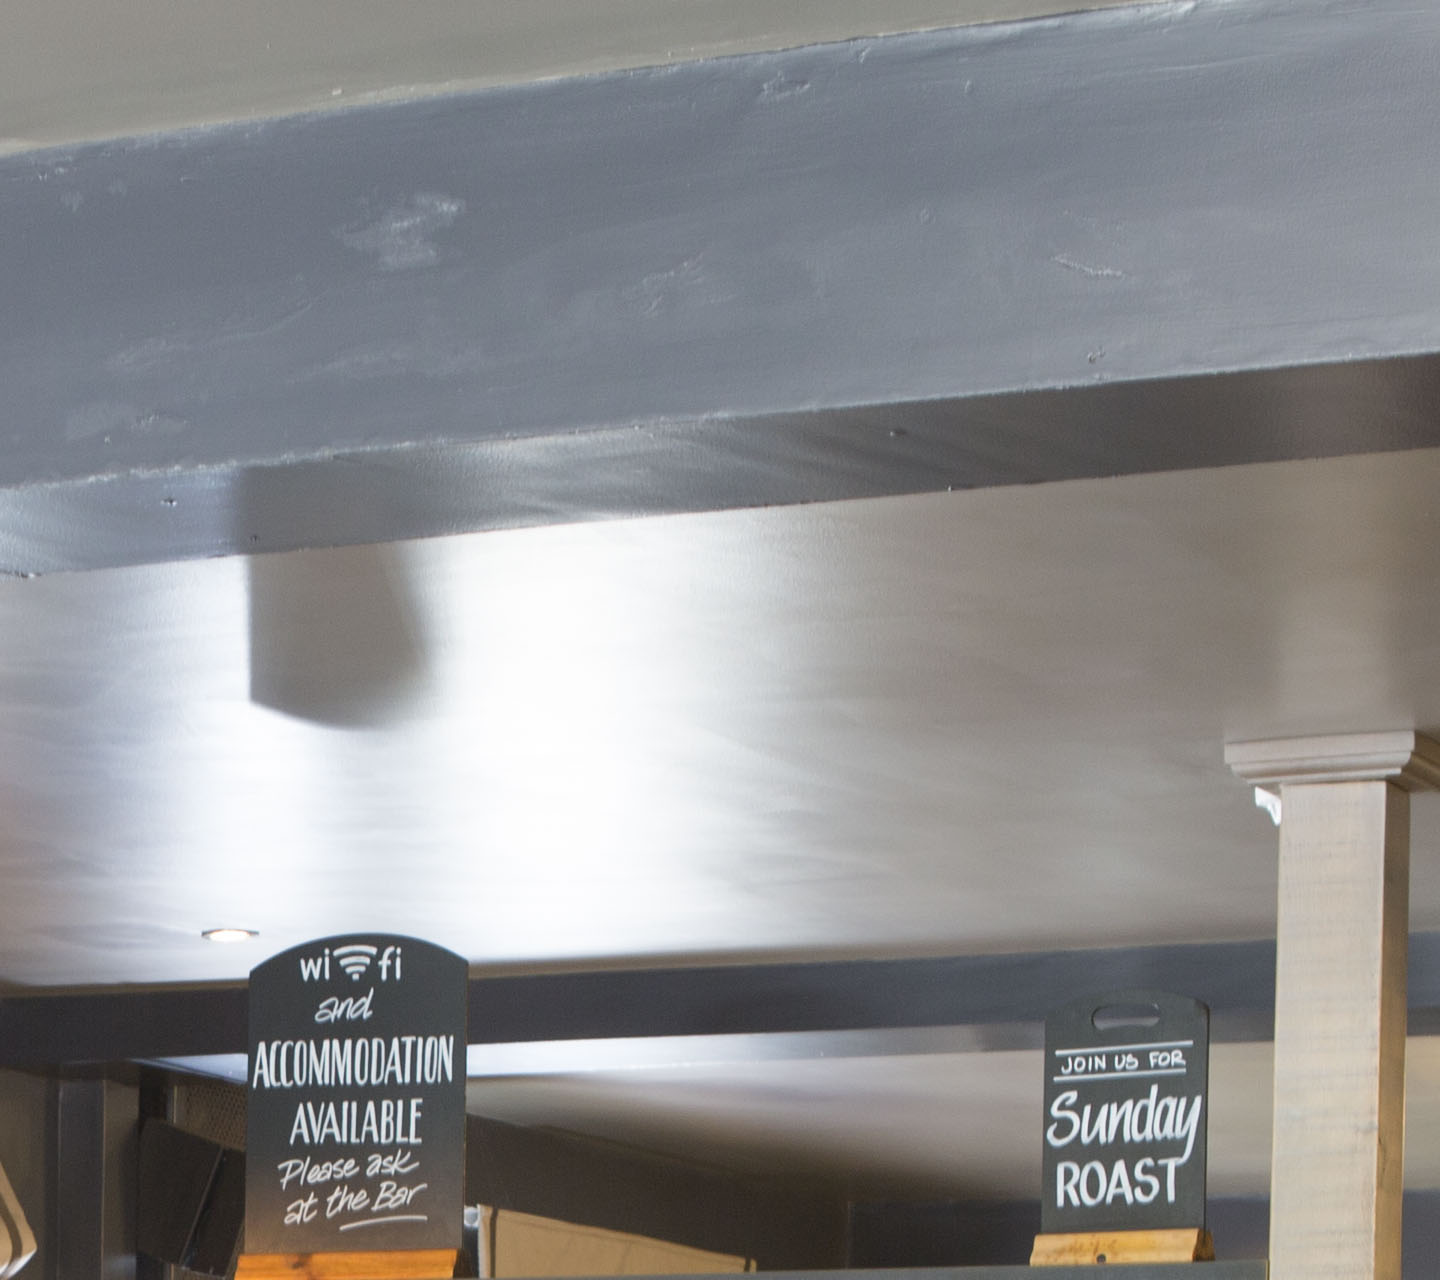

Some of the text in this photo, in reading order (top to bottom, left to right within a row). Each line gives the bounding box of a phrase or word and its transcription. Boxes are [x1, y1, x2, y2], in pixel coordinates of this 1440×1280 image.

[314, 987, 374, 1023] and
[252, 1035, 454, 1089] ACCOMMODATION
[1061, 1049, 1187, 1075] JOIN US FOR
[289, 1098, 423, 1145] AVAILABLE
[1046, 1083, 1203, 1164] Sunday
[277, 1148, 420, 1191] Please ask
[1056, 1155, 1184, 1209] ROAST
[283, 1180, 428, 1225] at the Bar
